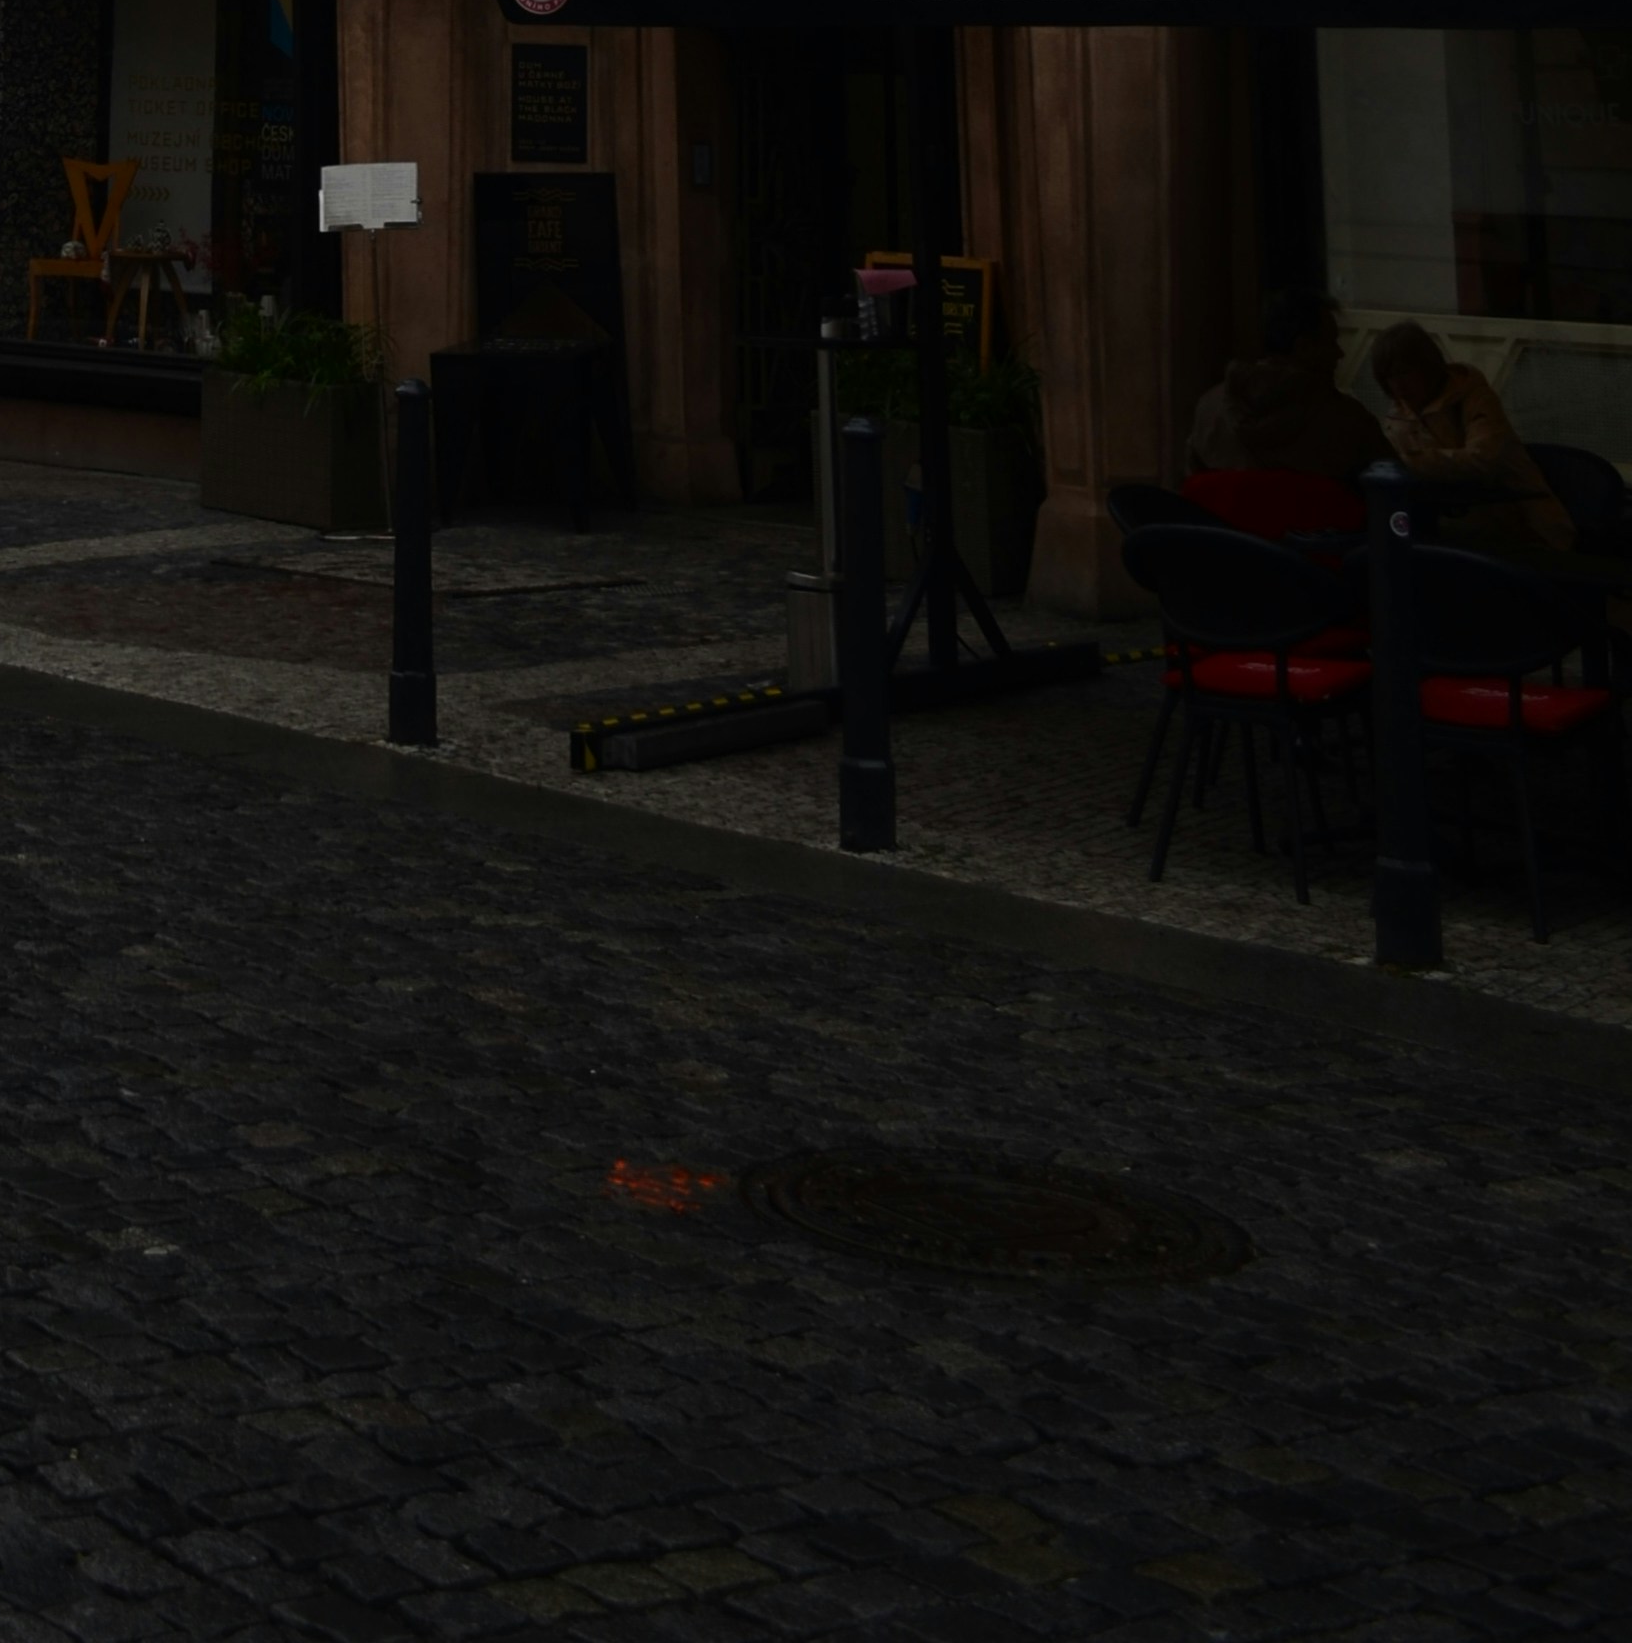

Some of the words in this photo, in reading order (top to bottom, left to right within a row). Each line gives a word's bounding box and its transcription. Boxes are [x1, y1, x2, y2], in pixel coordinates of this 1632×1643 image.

[128, 99, 187, 116] TICKET
[196, 100, 261, 120] OFFICE
[127, 127, 201, 149] MUZEJNÍ
[126, 155, 197, 173] MUSEUM
[205, 157, 253, 177] SHOP
[528, 218, 564, 240] CAFE
